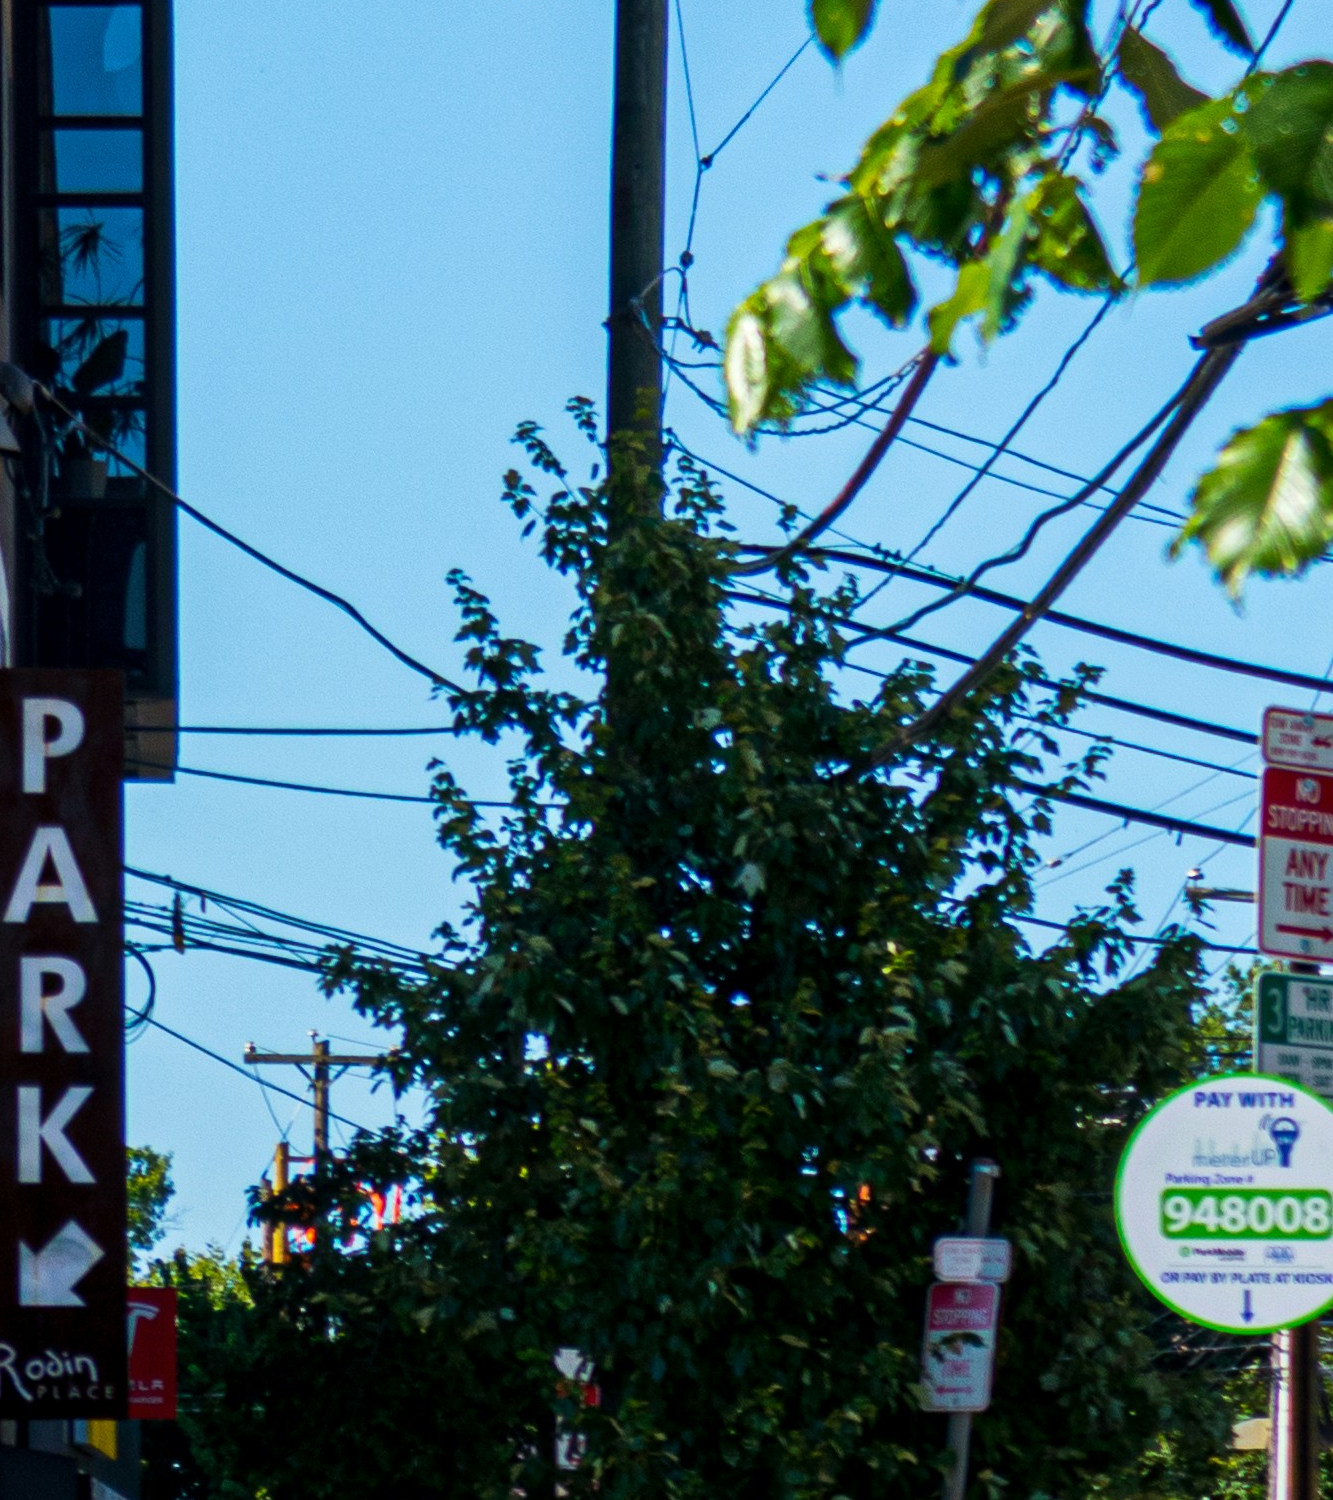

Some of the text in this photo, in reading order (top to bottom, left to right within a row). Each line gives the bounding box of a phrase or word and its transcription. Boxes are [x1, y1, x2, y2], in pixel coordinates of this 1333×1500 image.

[1295, 777, 1321, 804] NO
[1268, 804, 1333, 836] STOPPIN
[1285, 849, 1330, 882] ANY
[1283, 882, 1331, 917] TIME
[2, 697, 99, 1184] PARK
[1288, 1014, 1333, 1043] PARKIN
[1194, 1091, 1294, 1107] PAY WITH
[1163, 1195, 1331, 1233] 948008
[1232, 1272, 1271, 1284] PLATE
[36, 1385, 115, 1400] PLACE
